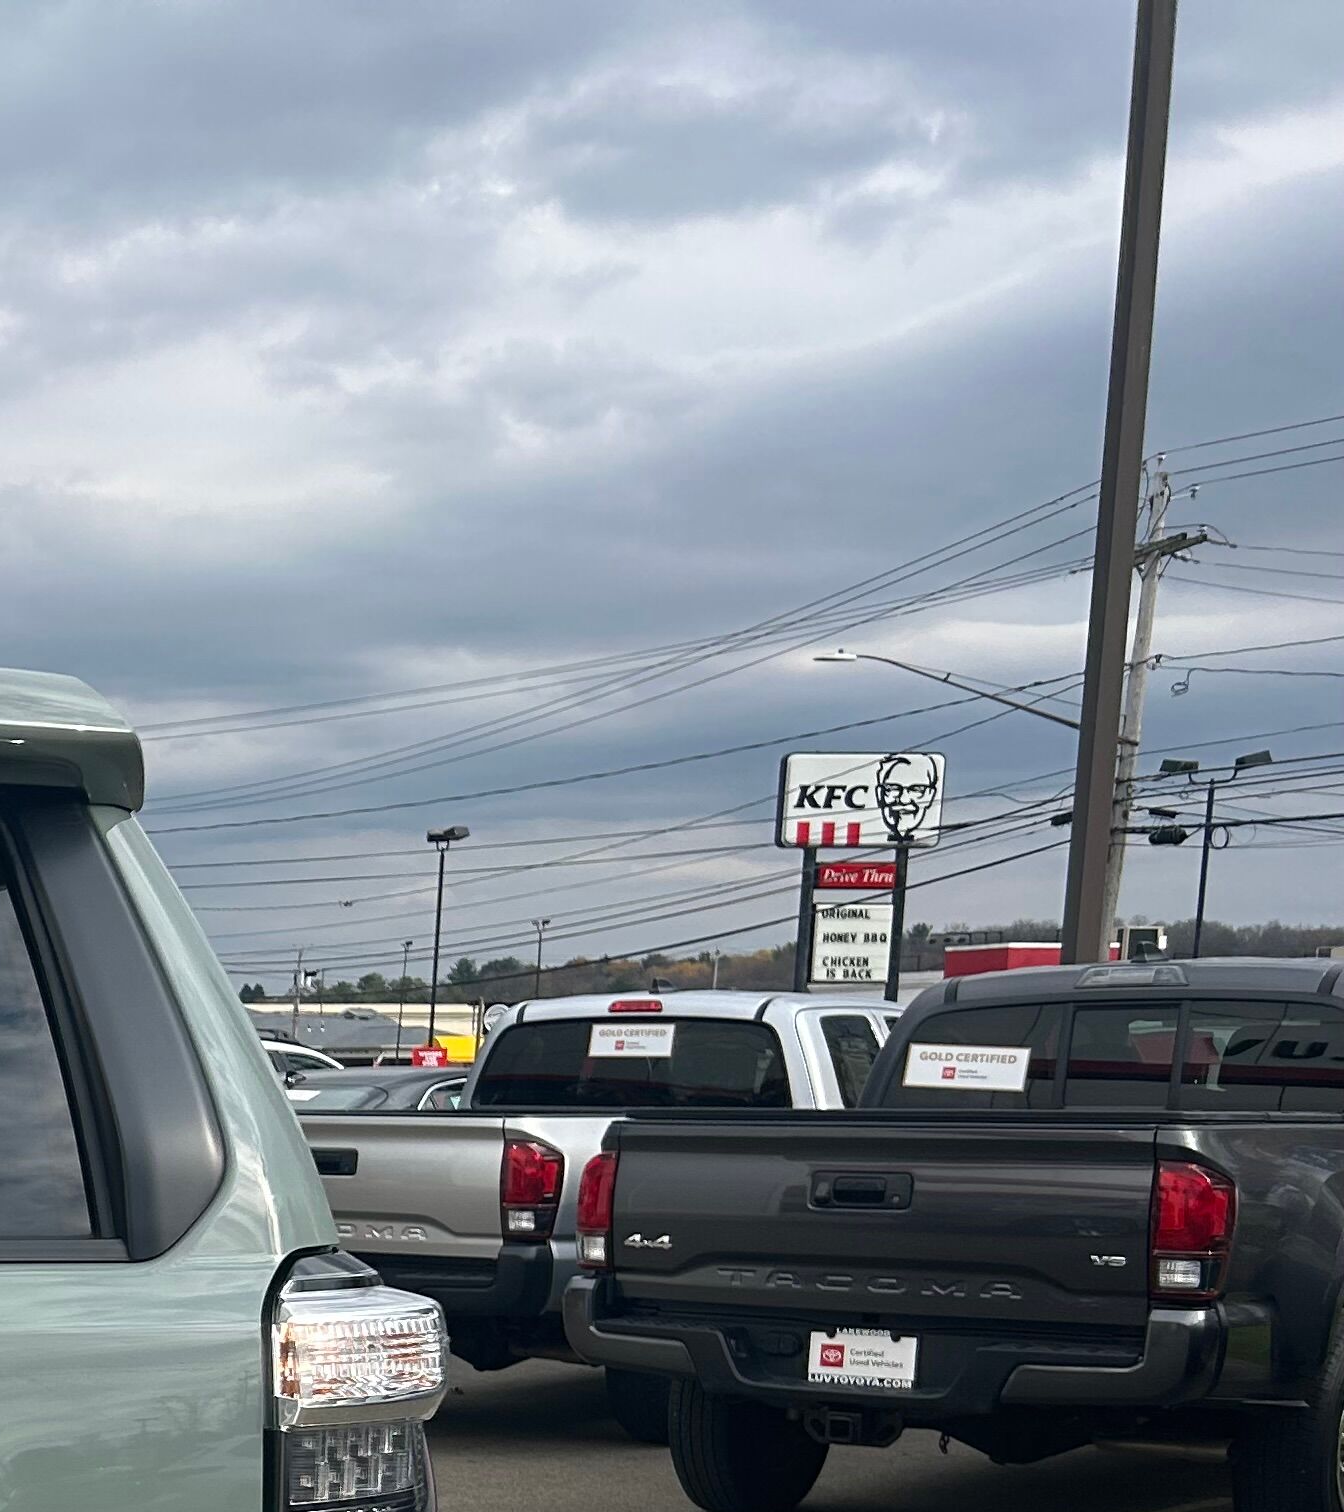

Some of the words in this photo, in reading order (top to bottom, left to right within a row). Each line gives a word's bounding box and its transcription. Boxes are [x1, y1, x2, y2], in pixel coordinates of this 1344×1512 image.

[793, 784, 869, 809] KFC
[823, 868, 858, 883] Drive
[863, 868, 894, 883] Thru
[821, 908, 871, 919] ORIGINAL
[822, 932, 857, 943] HONEY
[863, 932, 888, 943] BBQ
[822, 956, 869, 967] CHICKEN
[826, 968, 836, 979] IS
[843, 968, 872, 979] BACK
[599, 1028, 623, 1037] GOLD
[624, 1028, 667, 1037] CERTIFIED
[919, 1051, 954, 1061] GOLD
[956, 1053, 1017, 1064] CERTIFIED
[335, 1222, 428, 1241] OMA
[716, 1268, 1023, 1299] TACOMA
[849, 1348, 885, 1358] Certified
[849, 1358, 870, 1367] Used
[808, 1373, 912, 1389] LUVTOYOTA.COM
